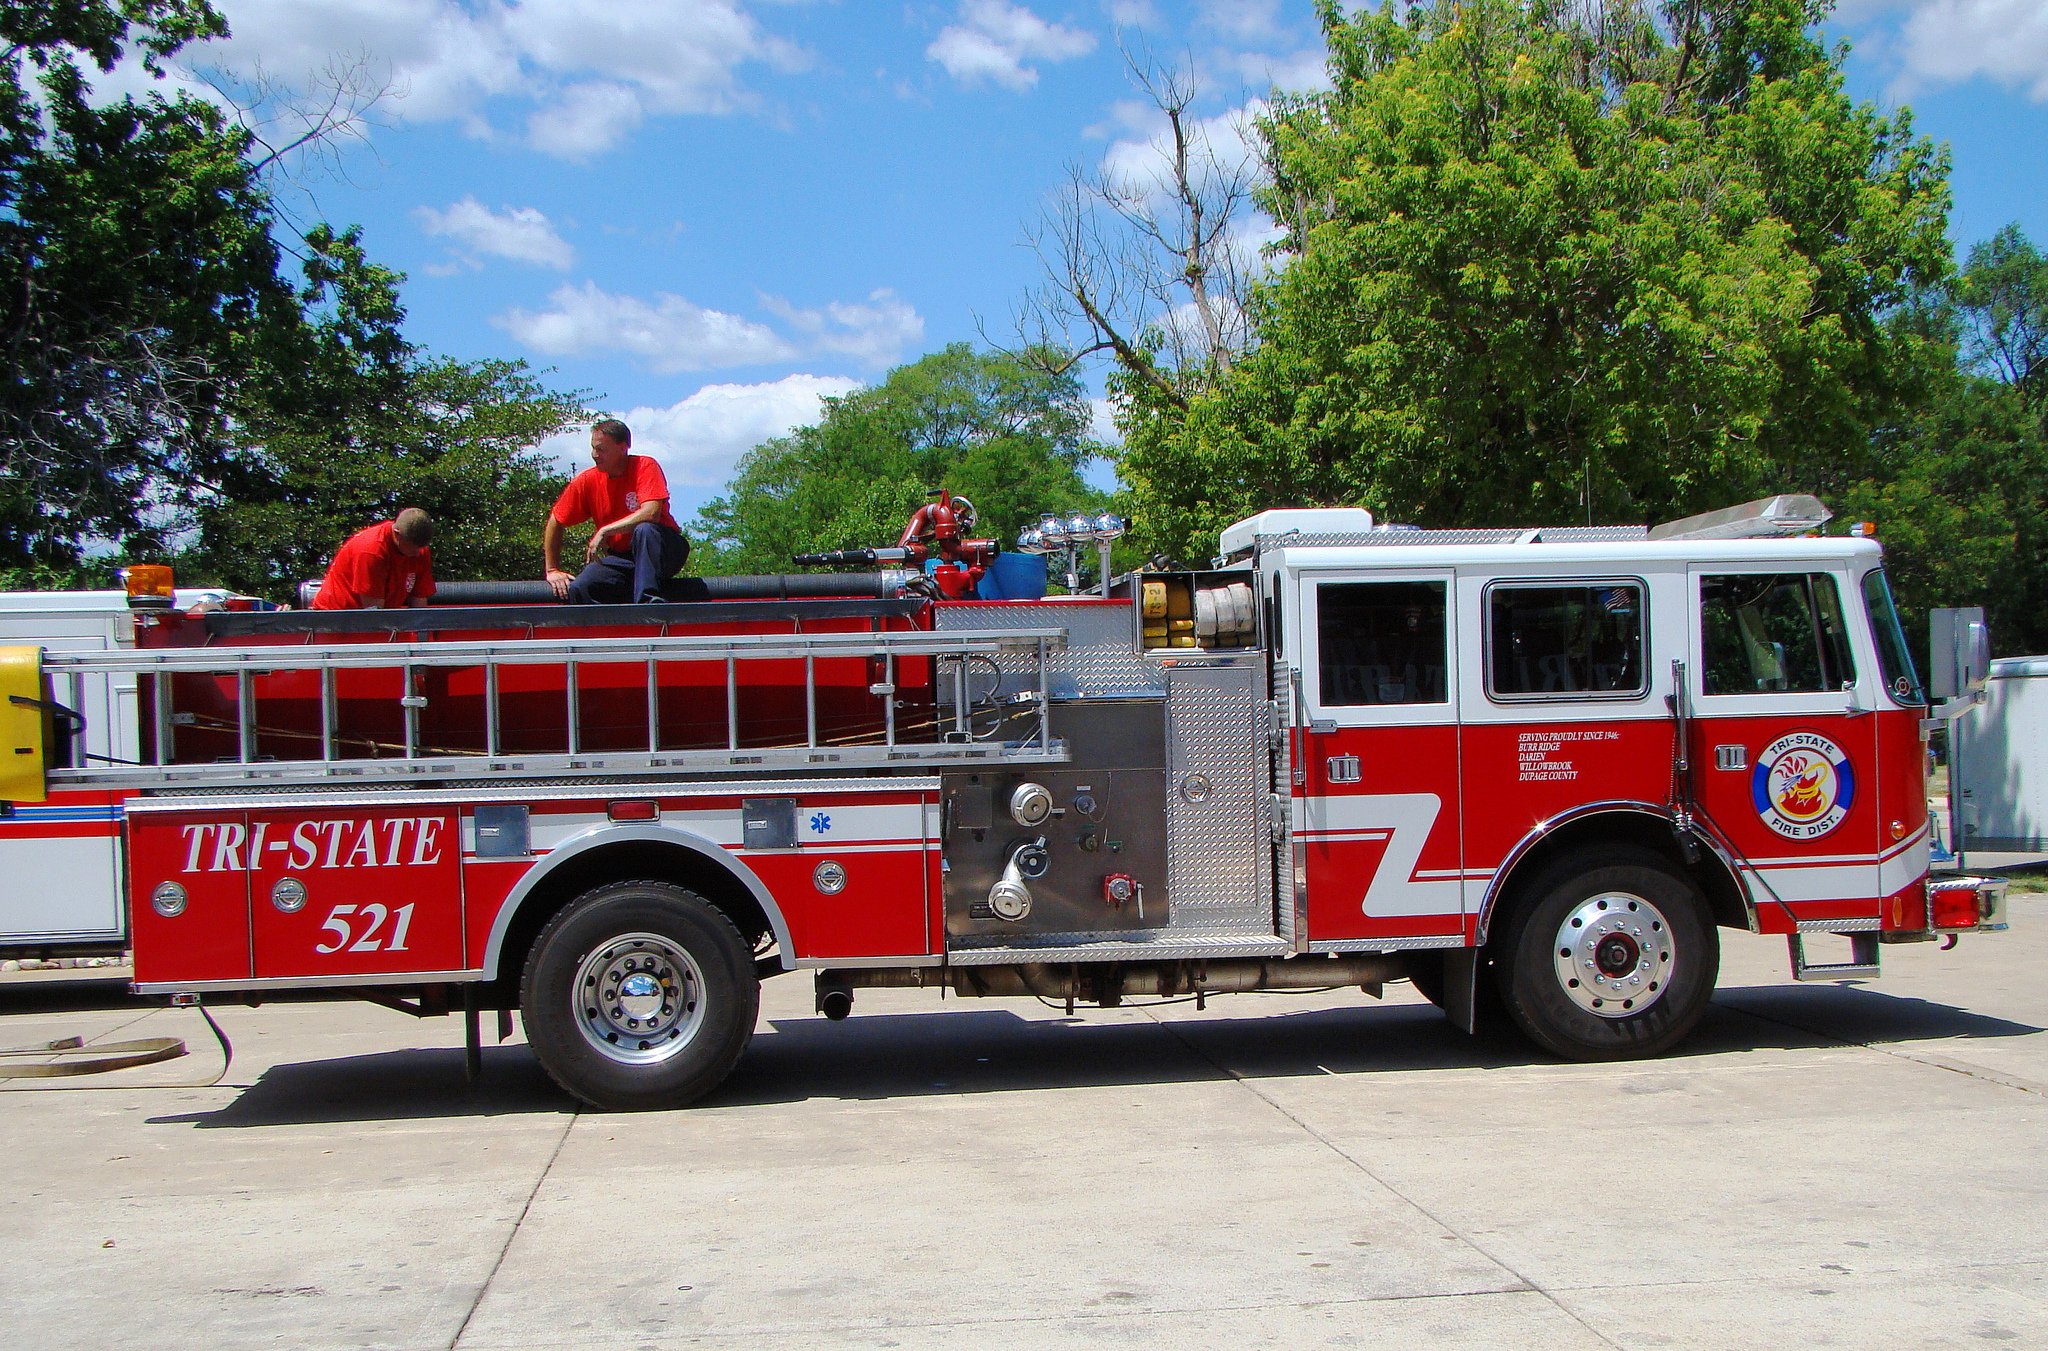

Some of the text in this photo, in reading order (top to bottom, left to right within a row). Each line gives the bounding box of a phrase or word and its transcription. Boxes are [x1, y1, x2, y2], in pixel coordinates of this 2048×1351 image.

[1518, 733, 1548, 742] SERVING
[1549, 732, 1583, 741] PROUDLY
[1583, 732, 1603, 740] SINCE
[1518, 742, 1561, 752] BURR RIDGE
[1770, 735, 1834, 755] TRI-STATE
[1519, 752, 1545, 761] DARIEN
[1519, 761, 1572, 771] WILLOWBROOK
[1519, 771, 1578, 781] DUPAGE COUNTY
[1771, 815, 1840, 836] FIRE DIST.
[181, 816, 446, 873] TRI-STATE
[315, 901, 416, 954] 521
